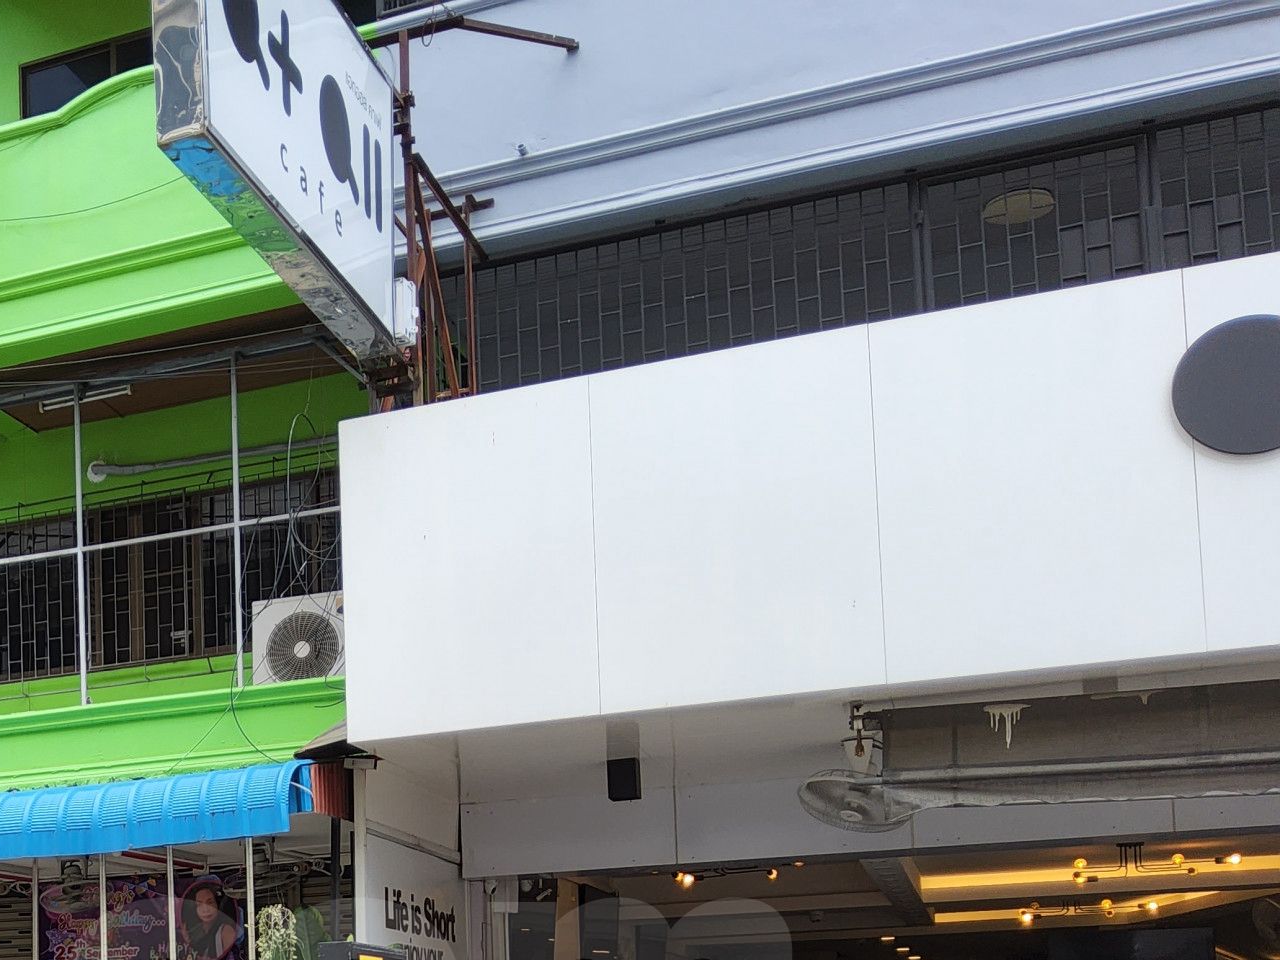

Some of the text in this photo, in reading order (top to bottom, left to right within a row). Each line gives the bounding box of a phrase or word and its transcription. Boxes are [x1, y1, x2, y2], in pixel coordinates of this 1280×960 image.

[280, 143, 342, 237] cafe
[385, 887, 456, 942] Life is Short
